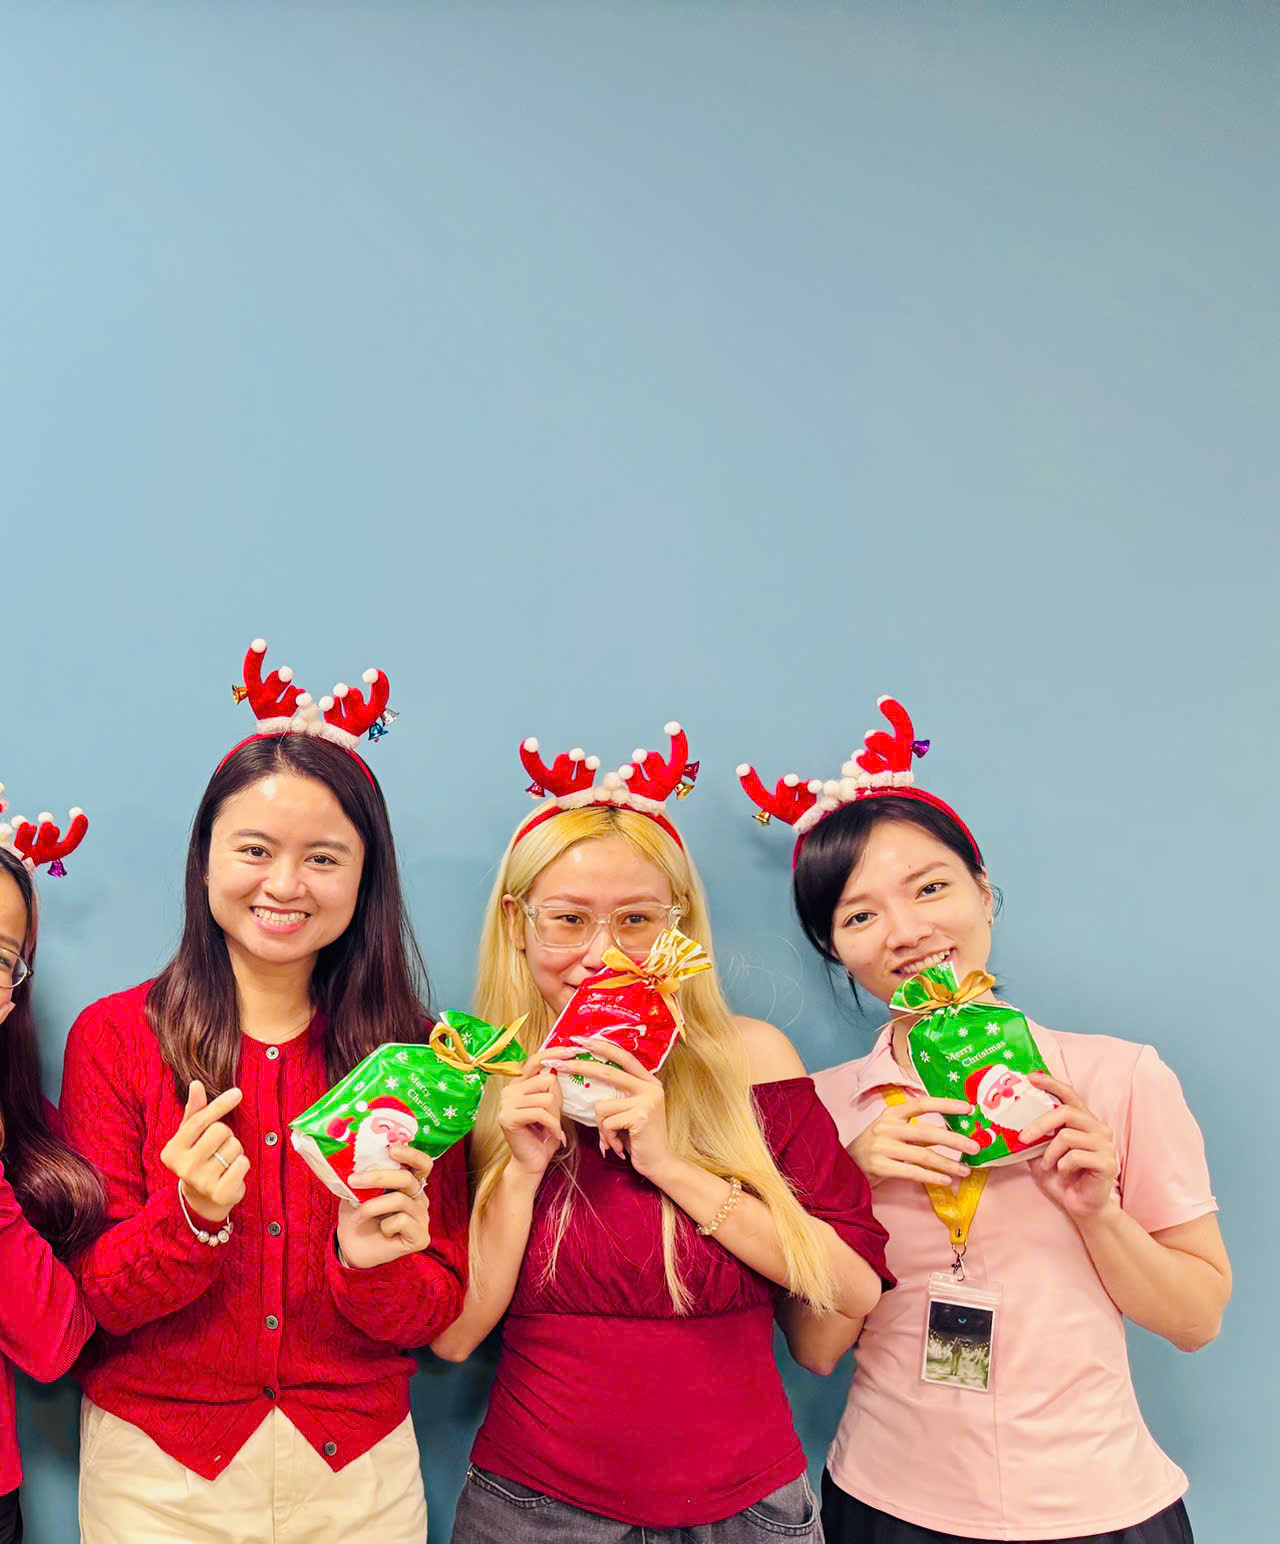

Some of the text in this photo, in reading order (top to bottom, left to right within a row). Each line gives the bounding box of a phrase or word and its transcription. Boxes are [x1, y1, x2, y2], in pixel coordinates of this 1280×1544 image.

[945, 1044, 973, 1063] Merry
[961, 1040, 1006, 1067] Christmas
[408, 1073, 431, 1097] Merry
[407, 1088, 441, 1127] Christmas
